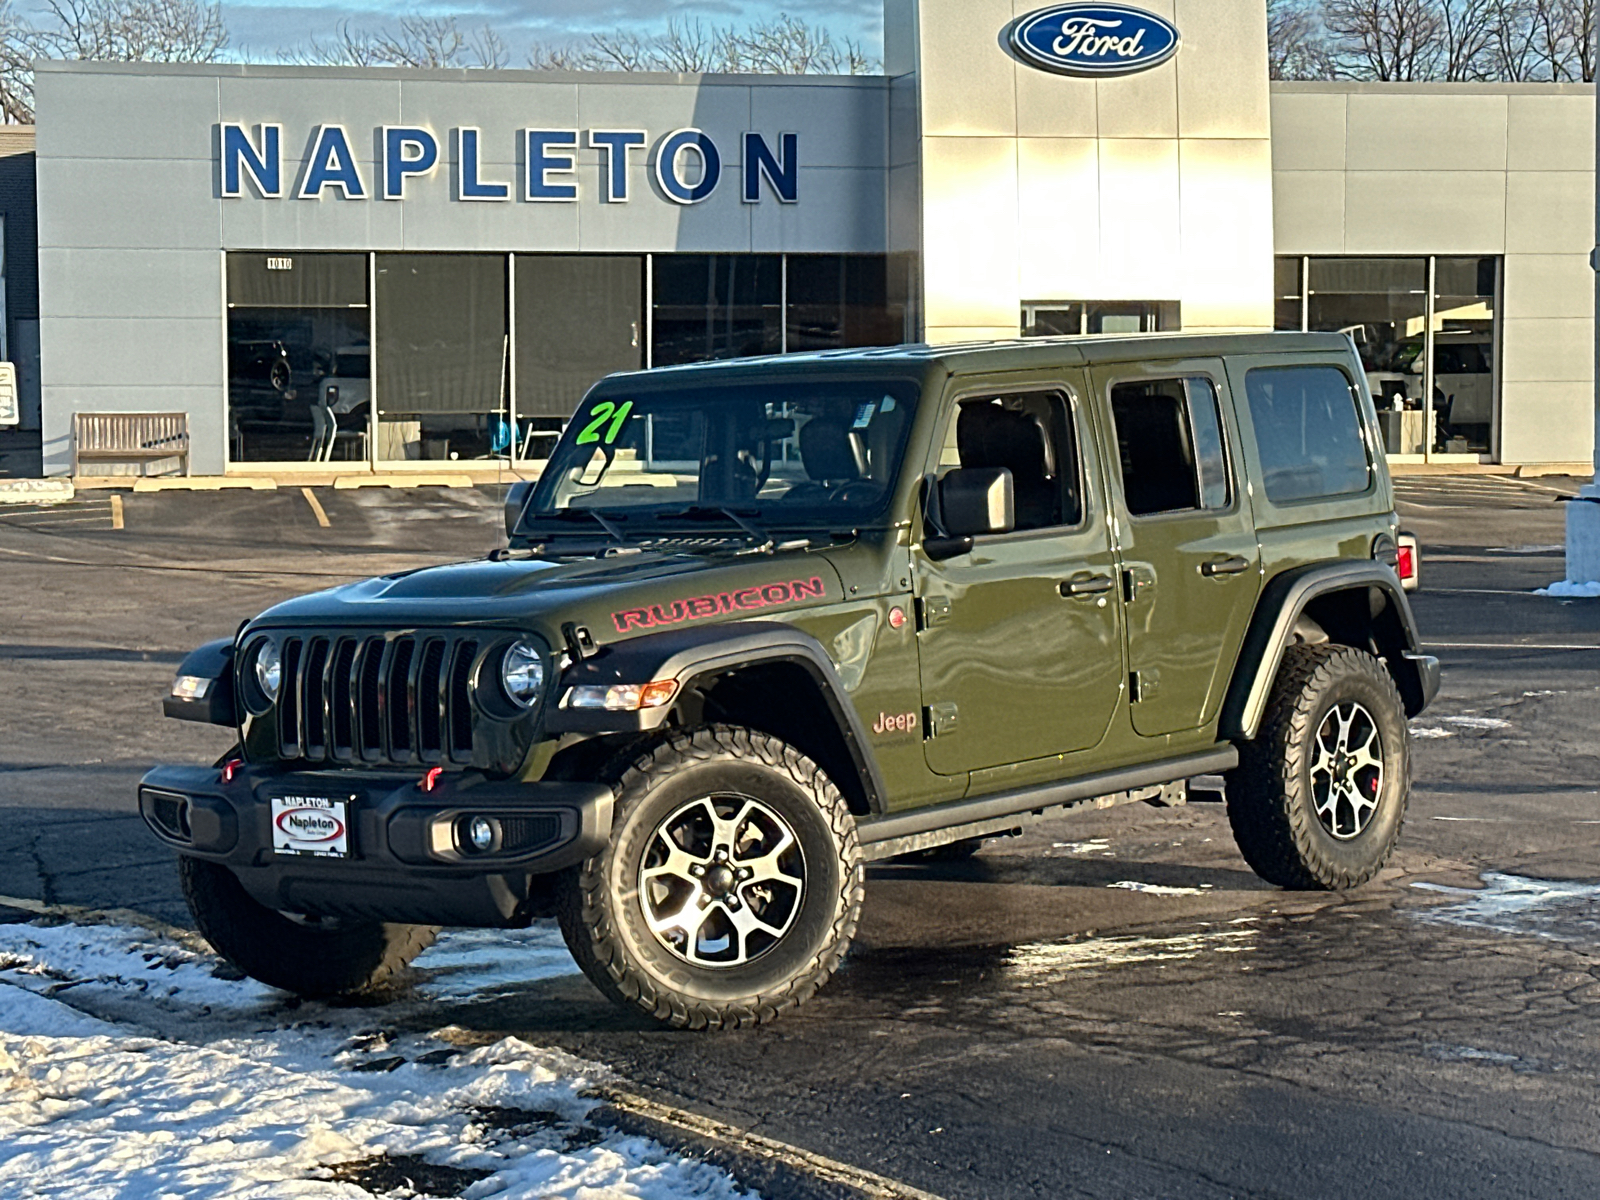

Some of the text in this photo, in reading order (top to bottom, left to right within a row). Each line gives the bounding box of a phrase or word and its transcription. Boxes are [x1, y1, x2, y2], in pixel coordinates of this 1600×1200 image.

[1053, 17, 1146, 56] Ford
[220, 122, 798, 204] NAPLETON
[268, 258, 291, 269] 1010
[576, 401, 633, 445] 21
[611, 577, 825, 633] RUBICON
[873, 712, 916, 733] Jeep
[284, 796, 330, 808] NAPLETON
[289, 815, 334, 830] Napleton
